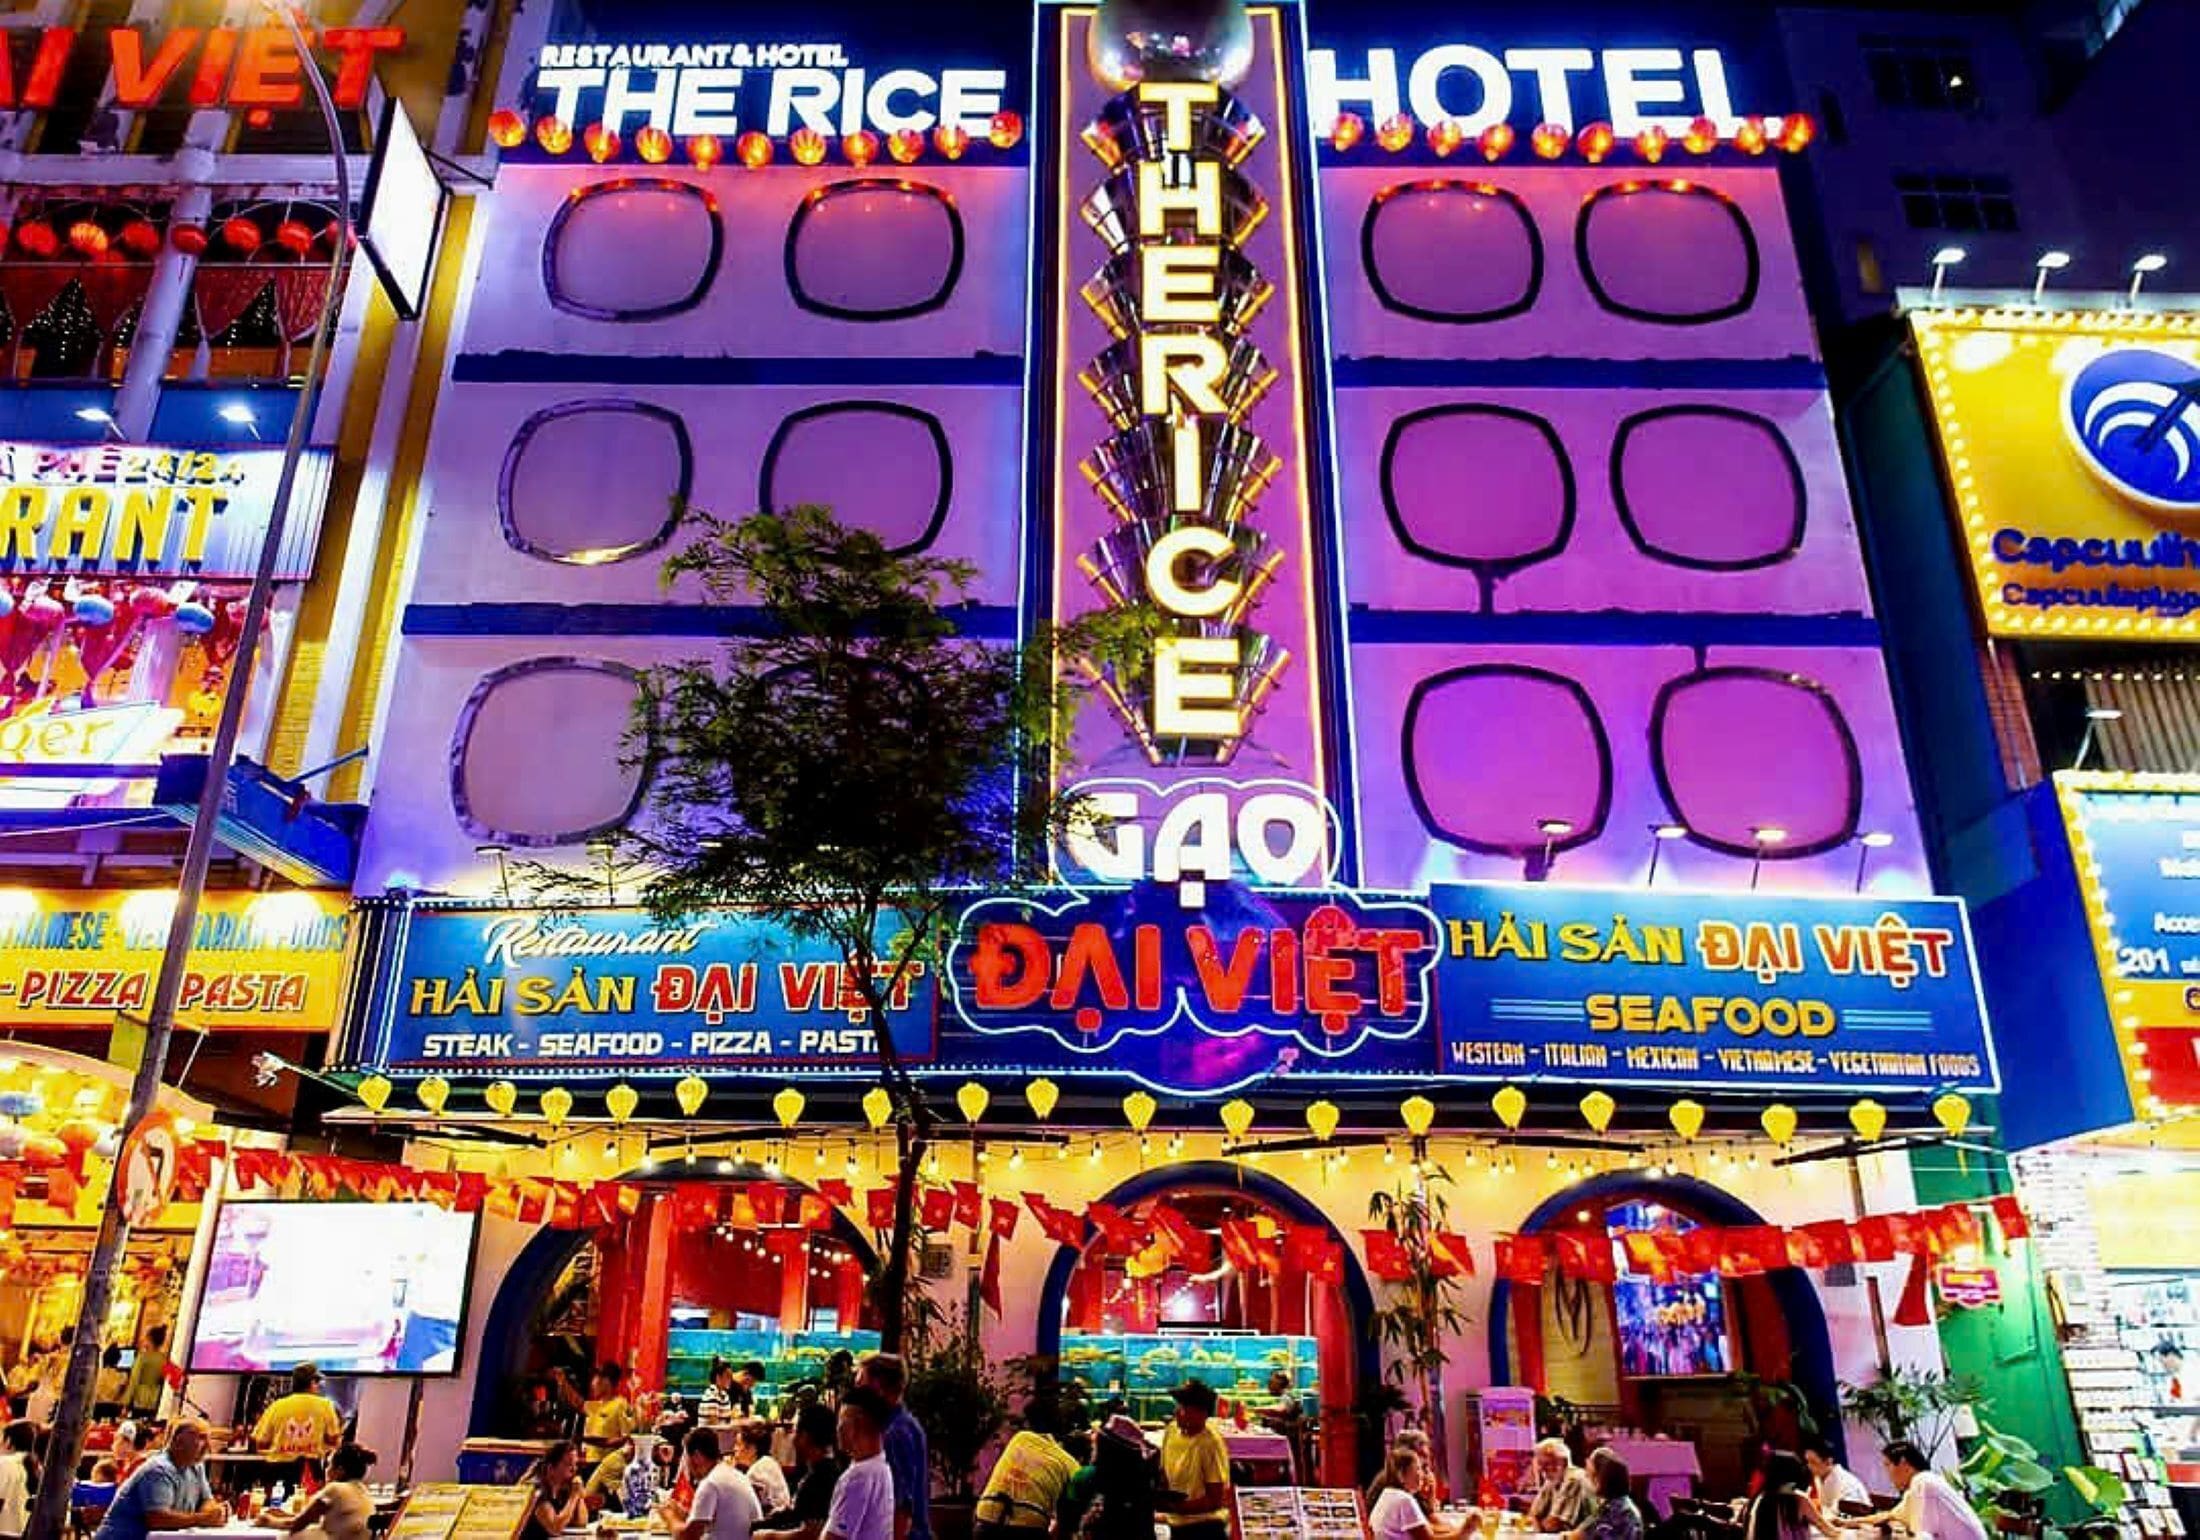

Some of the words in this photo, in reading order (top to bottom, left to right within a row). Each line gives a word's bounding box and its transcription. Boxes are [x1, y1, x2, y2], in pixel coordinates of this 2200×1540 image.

[0, 28, 76, 106] I
[1308, 44, 1782, 139] HOTEL
[537, 68, 743, 137] THE
[767, 68, 1006, 138] RICE
[1066, 792, 1322, 908] GẠO
[484, 914, 719, 968] Restaurant
[970, 923, 1161, 1032] ĐẠI
[1186, 906, 1424, 1034] VIỆT
[1446, 911, 1549, 960] HẢI
[1560, 912, 1684, 964] SẢN
[1697, 919, 1804, 984] ĐẠI
[1815, 912, 1953, 988] VIỆT
[17, 968, 148, 1010] PIZZA
[176, 971, 309, 1012] PASTA
[409, 966, 503, 1015] HẢI
[515, 966, 635, 1015] SẢN
[652, 962, 757, 1024] ĐẠI
[1586, 994, 1837, 1037] SEAFOOD
[422, 1033, 513, 1059] STEAK
[537, 1031, 665, 1057] SEAFOOD
[690, 1030, 772, 1056] PIZZA
[799, 1029, 879, 1055] PAST
[1451, 1041, 1525, 1066] WESTERN
[1545, 1042, 1608, 1068] ITALIAN
[1626, 1045, 1699, 1070] MEXICAN
